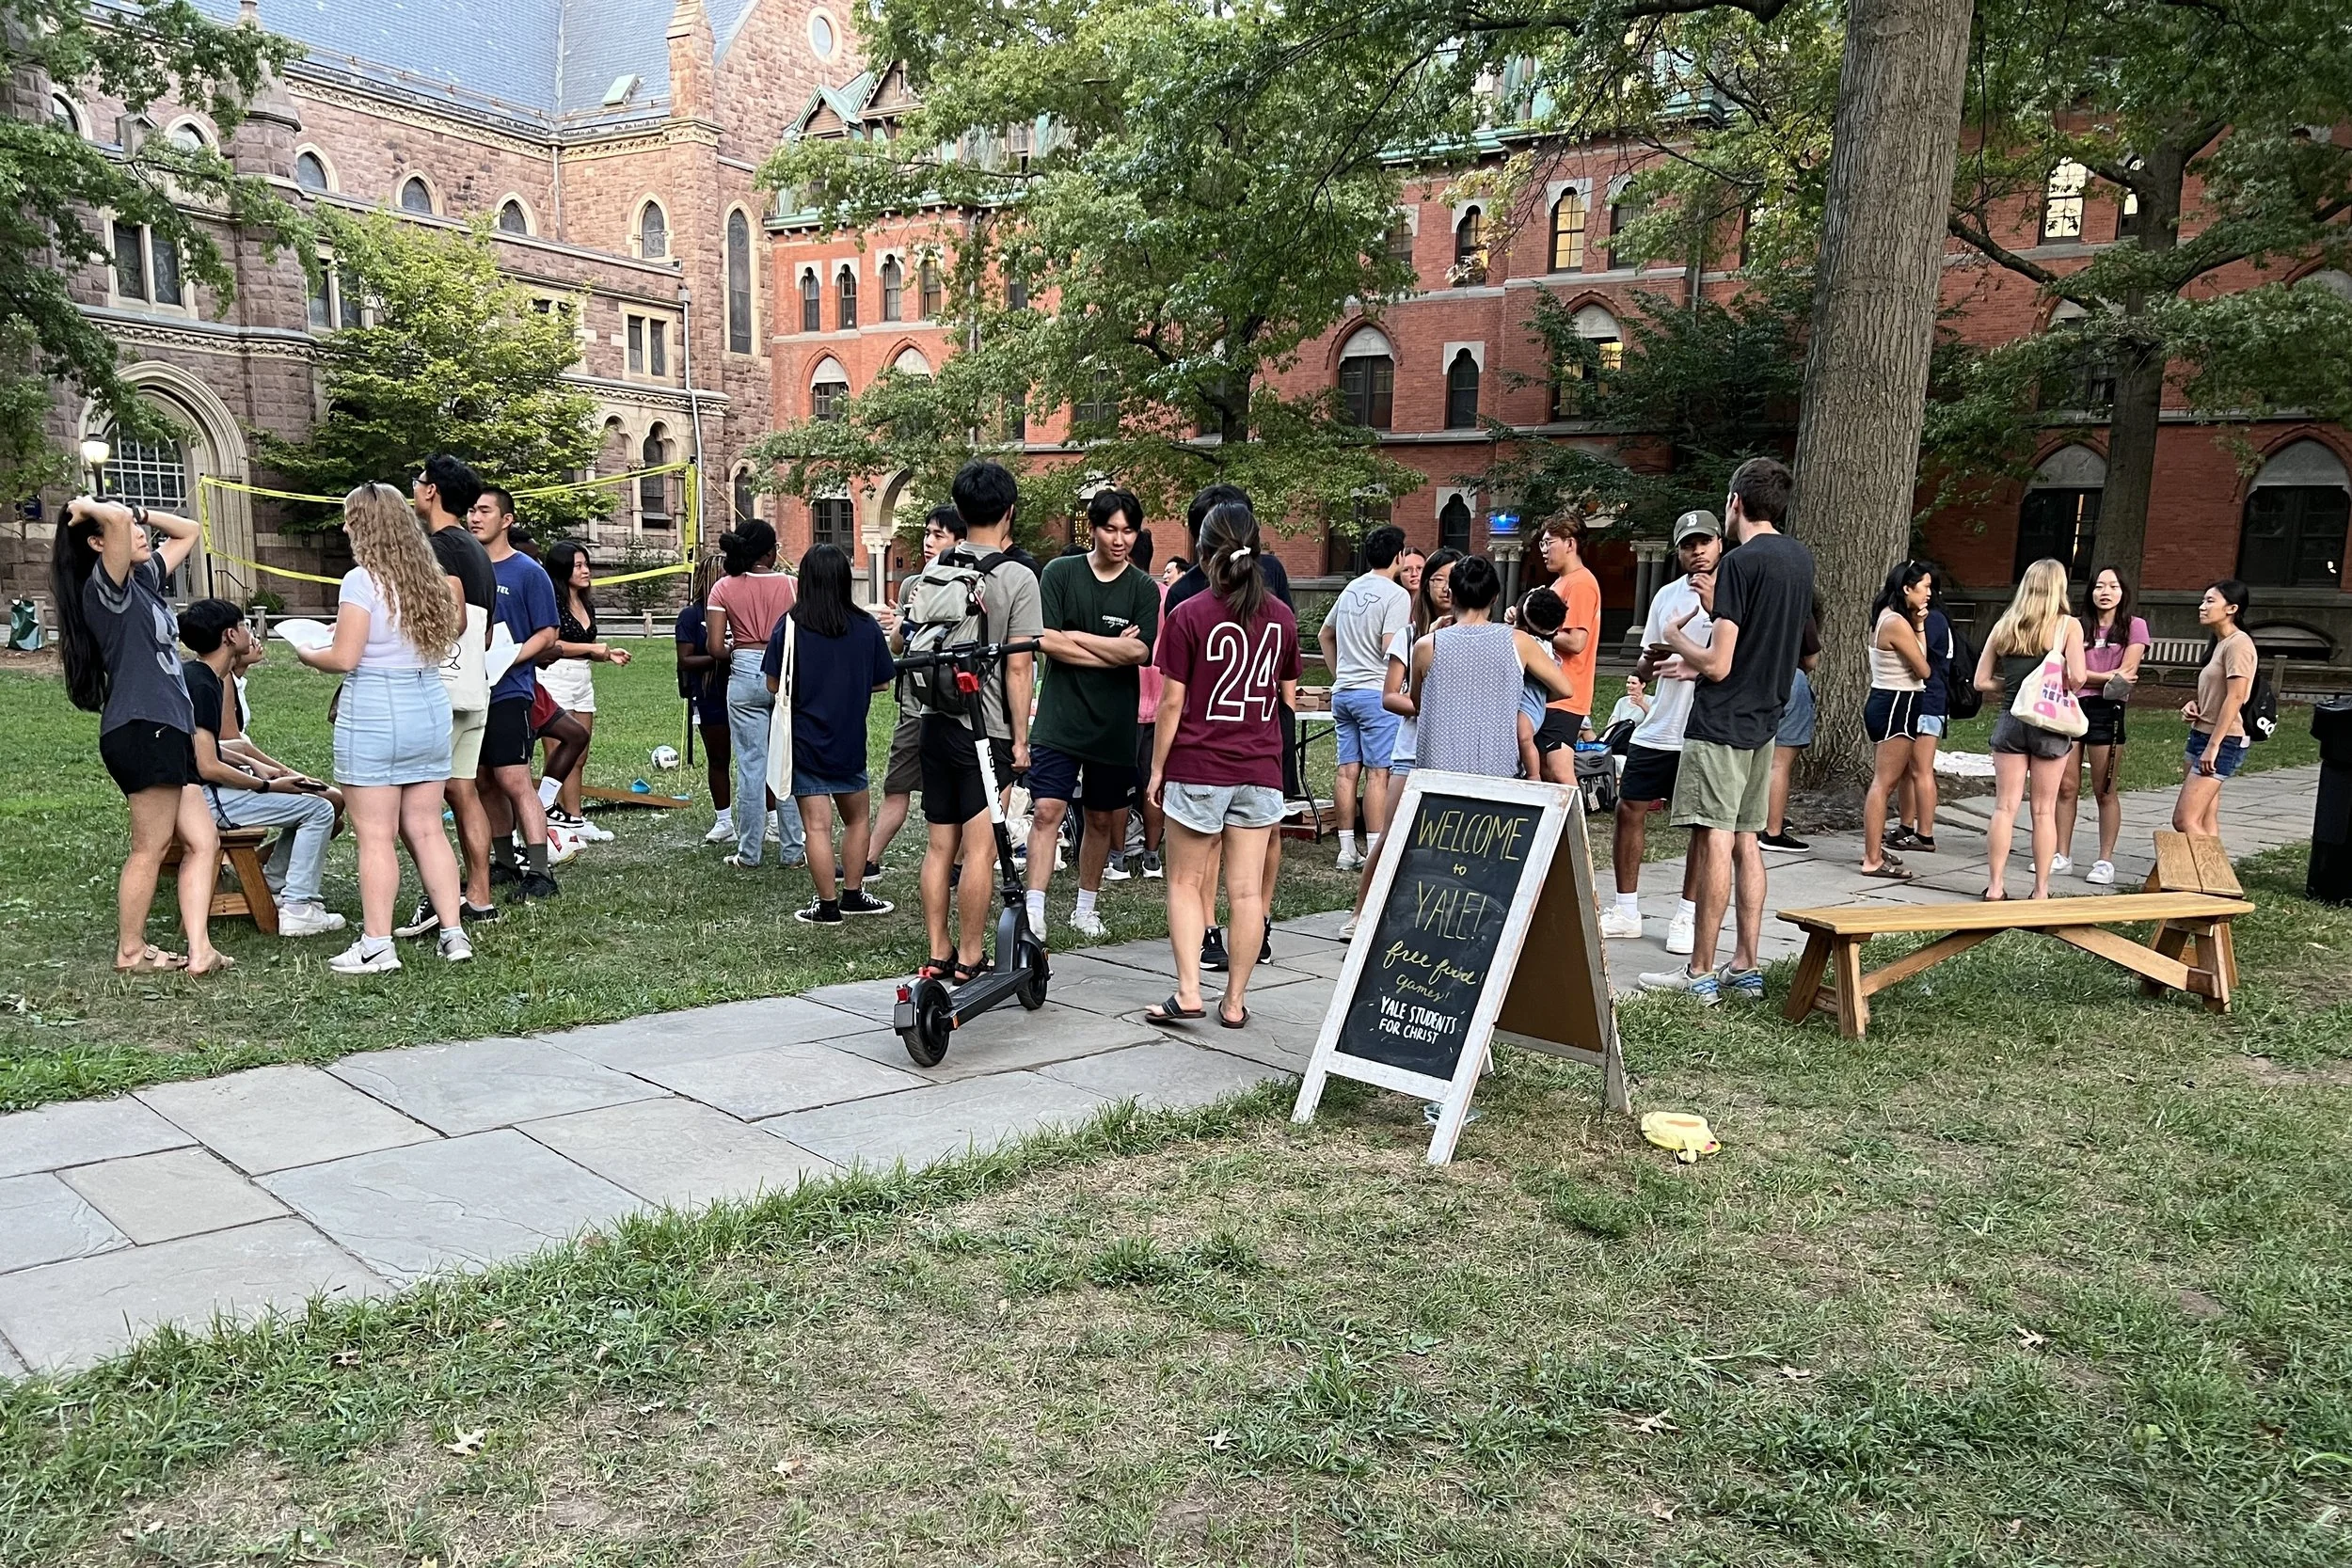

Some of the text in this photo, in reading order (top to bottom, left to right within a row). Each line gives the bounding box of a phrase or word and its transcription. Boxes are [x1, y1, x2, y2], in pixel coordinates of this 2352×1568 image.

[1687, 514, 1697, 527] B
[1206, 622, 1281, 721] 24
[1418, 809, 1529, 861] WELCOME
[1453, 863, 1467, 876] to
[1415, 880, 1487, 940] YALE!
[1383, 941, 1432, 969] free
[1378, 1018, 1438, 1045] FOR CHRIST
[1380, 995, 1457, 1035] YALE STUDENTS
